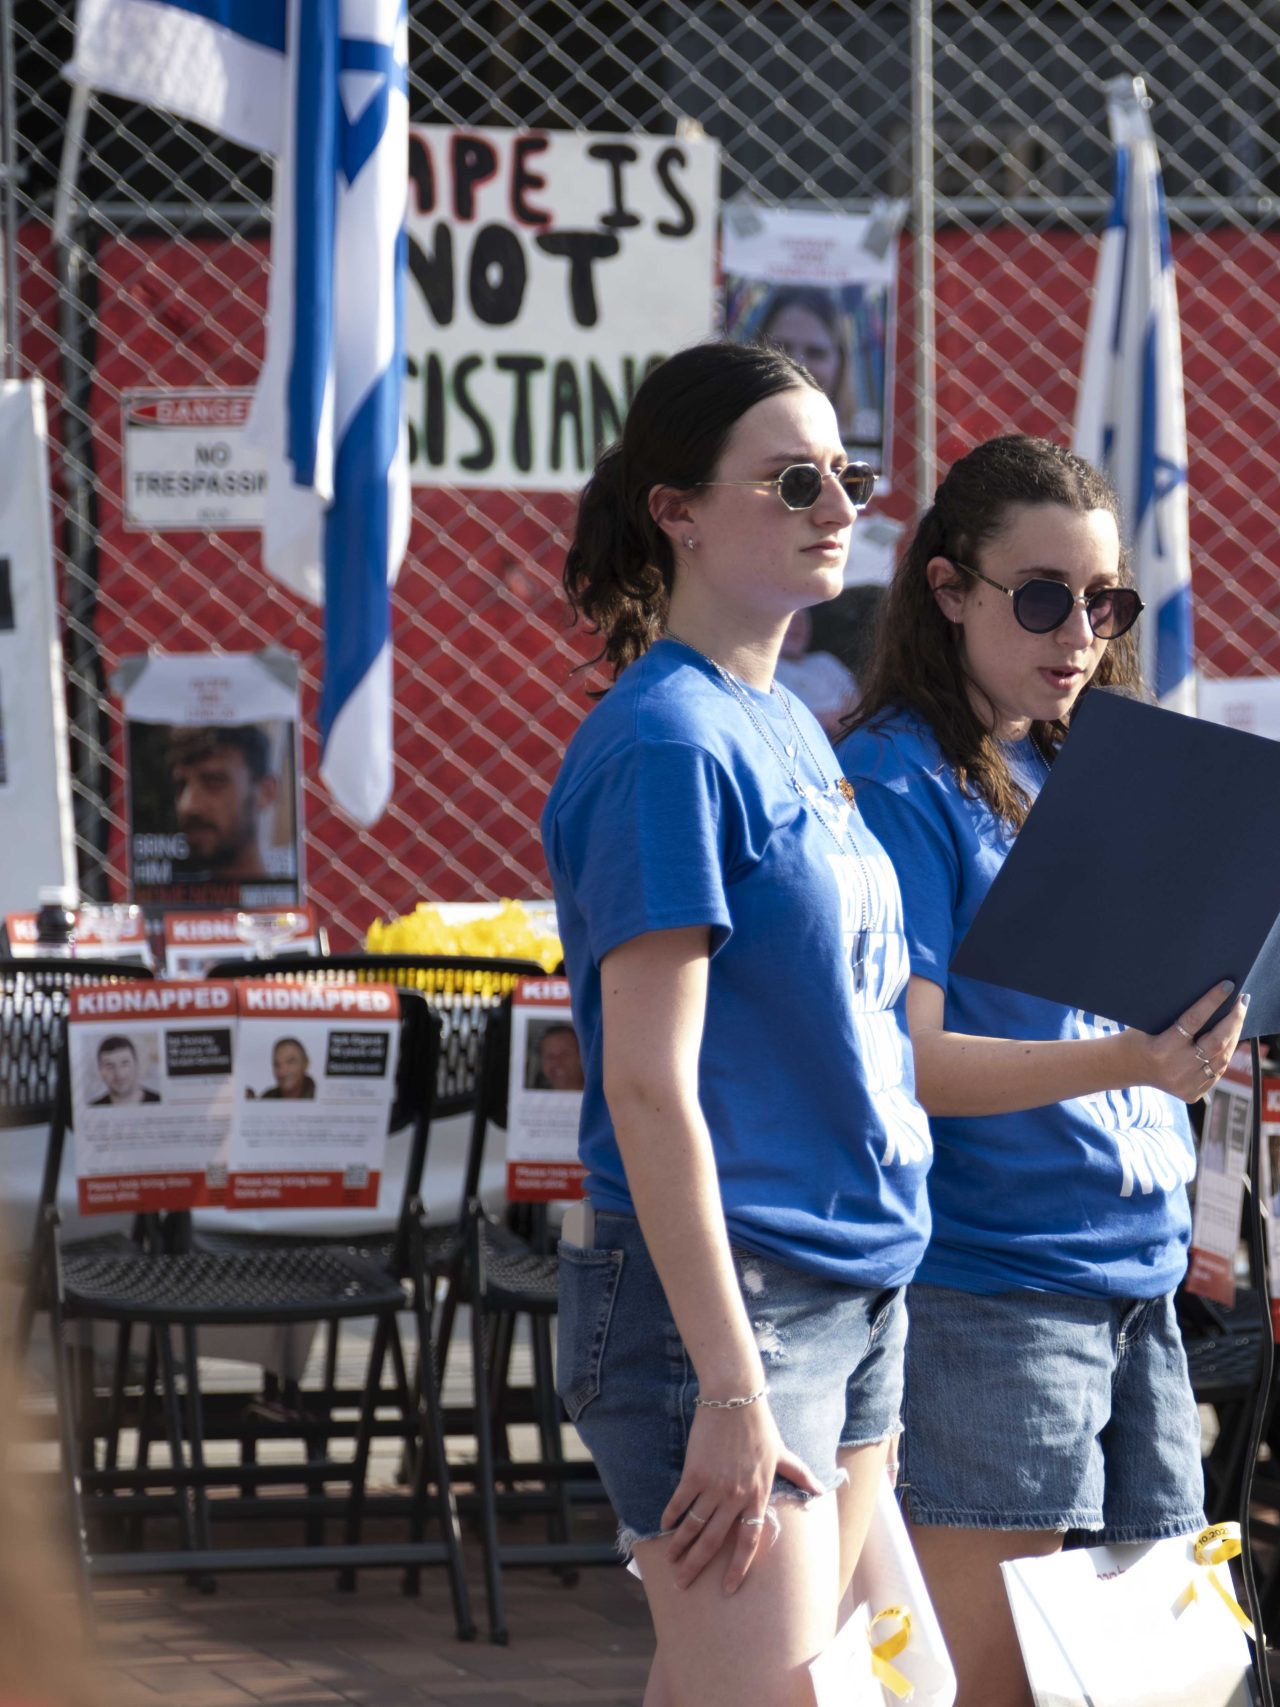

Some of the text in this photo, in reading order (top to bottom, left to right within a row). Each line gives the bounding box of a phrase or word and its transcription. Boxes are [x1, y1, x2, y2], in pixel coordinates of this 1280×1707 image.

[406, 130, 695, 238] APE IS
[406, 221, 620, 328] NOT
[158, 400, 248, 422] DANGE
[195, 442, 231, 468] NO
[77, 987, 229, 1014] KIDNAPPED
[247, 988, 391, 1013] KIDNAPPED
